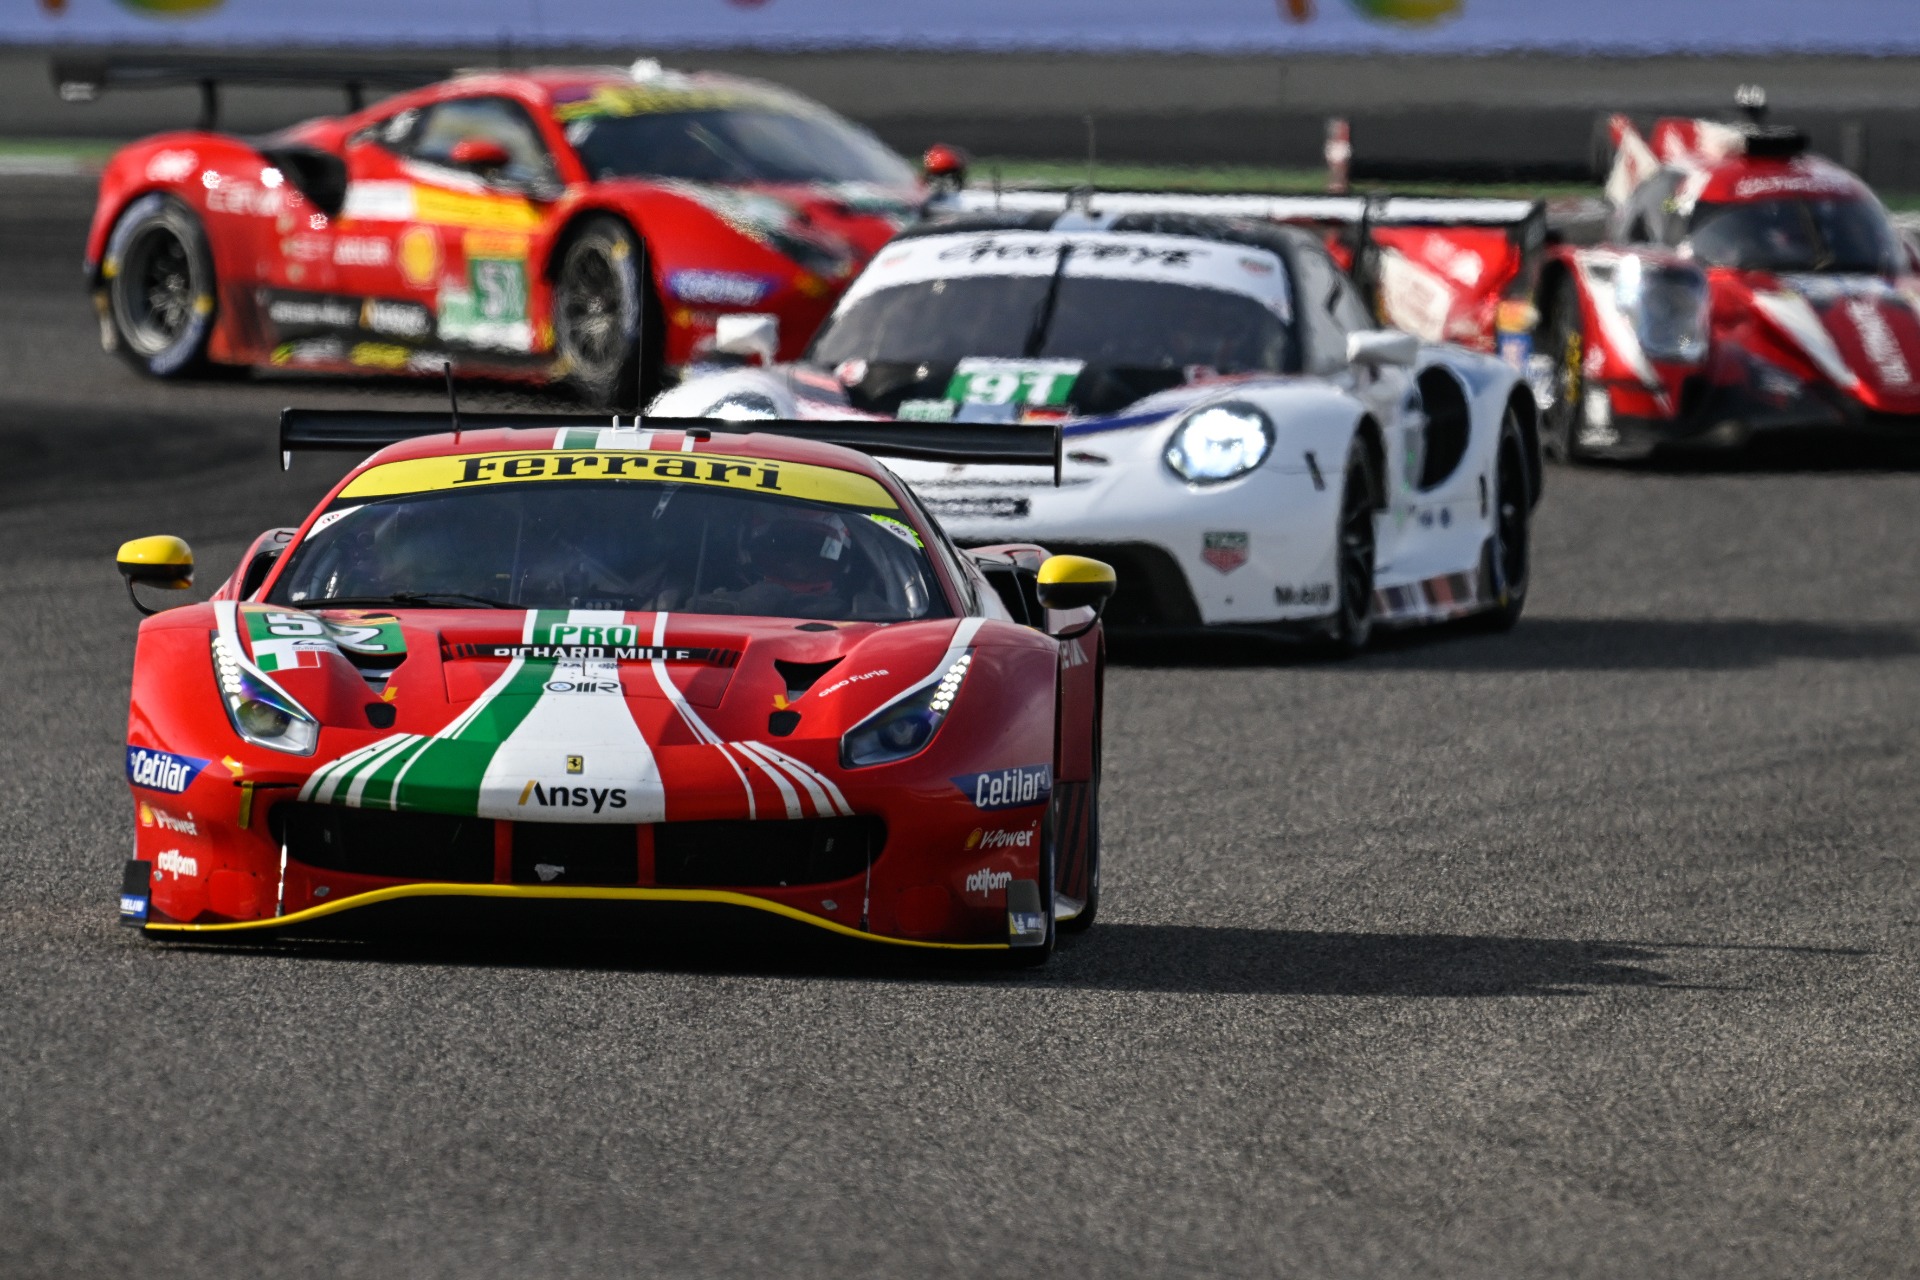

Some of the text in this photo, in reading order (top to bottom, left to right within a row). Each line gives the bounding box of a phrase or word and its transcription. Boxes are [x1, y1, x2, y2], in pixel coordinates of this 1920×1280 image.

[968, 374, 1055, 405] 91
[453, 450, 782, 491] Ferrari
[554, 626, 632, 646] PRO
[133, 750, 191, 793] Cetilar
[975, 768, 1041, 808] Cetilar
[518, 779, 627, 814] Ansys
[979, 828, 1033, 850] V-Power
[966, 867, 1012, 898] rotiform
